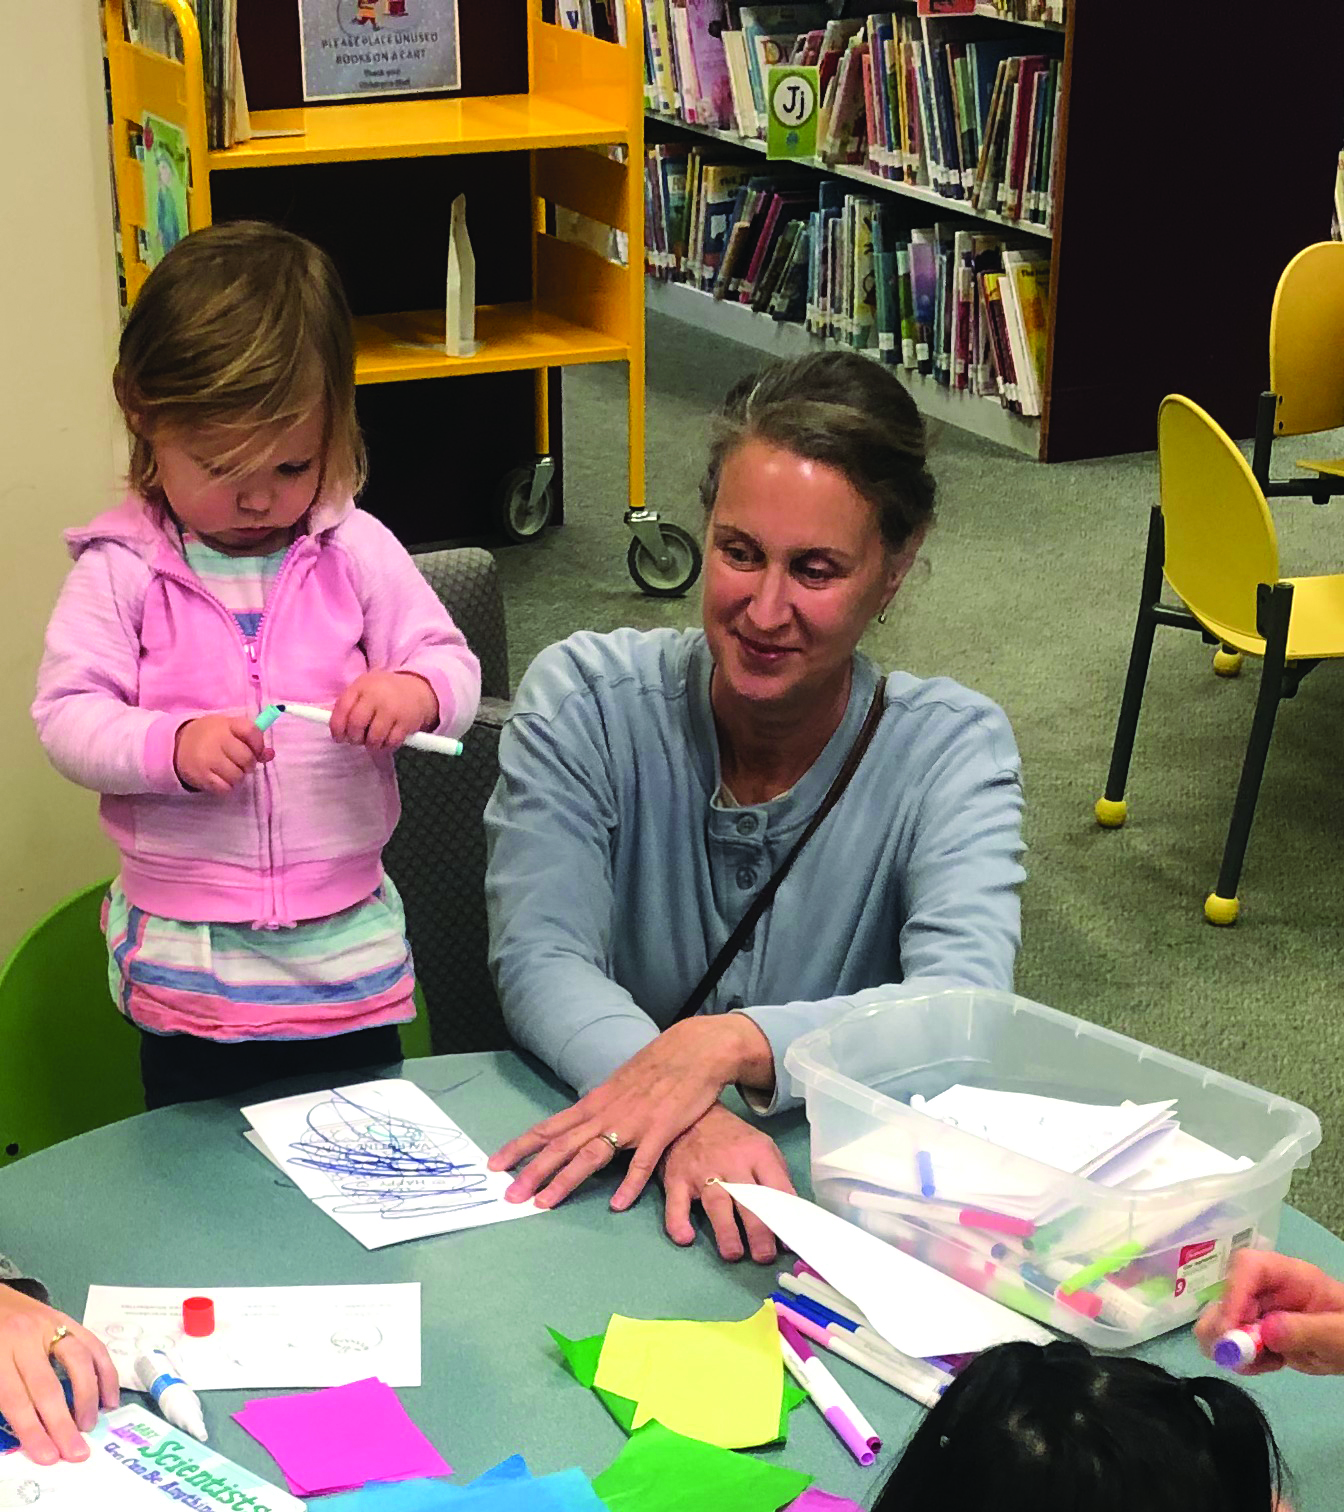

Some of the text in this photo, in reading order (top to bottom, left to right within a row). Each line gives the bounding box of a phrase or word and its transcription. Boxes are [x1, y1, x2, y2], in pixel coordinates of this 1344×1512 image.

[321, 32, 438, 48] PLEASE PLACE UNUSED
[336, 52, 372, 64] BOOKS
[373, 52, 389, 62] ON
[400, 49, 426, 59] CART
[782, 85, 805, 120] Jj
